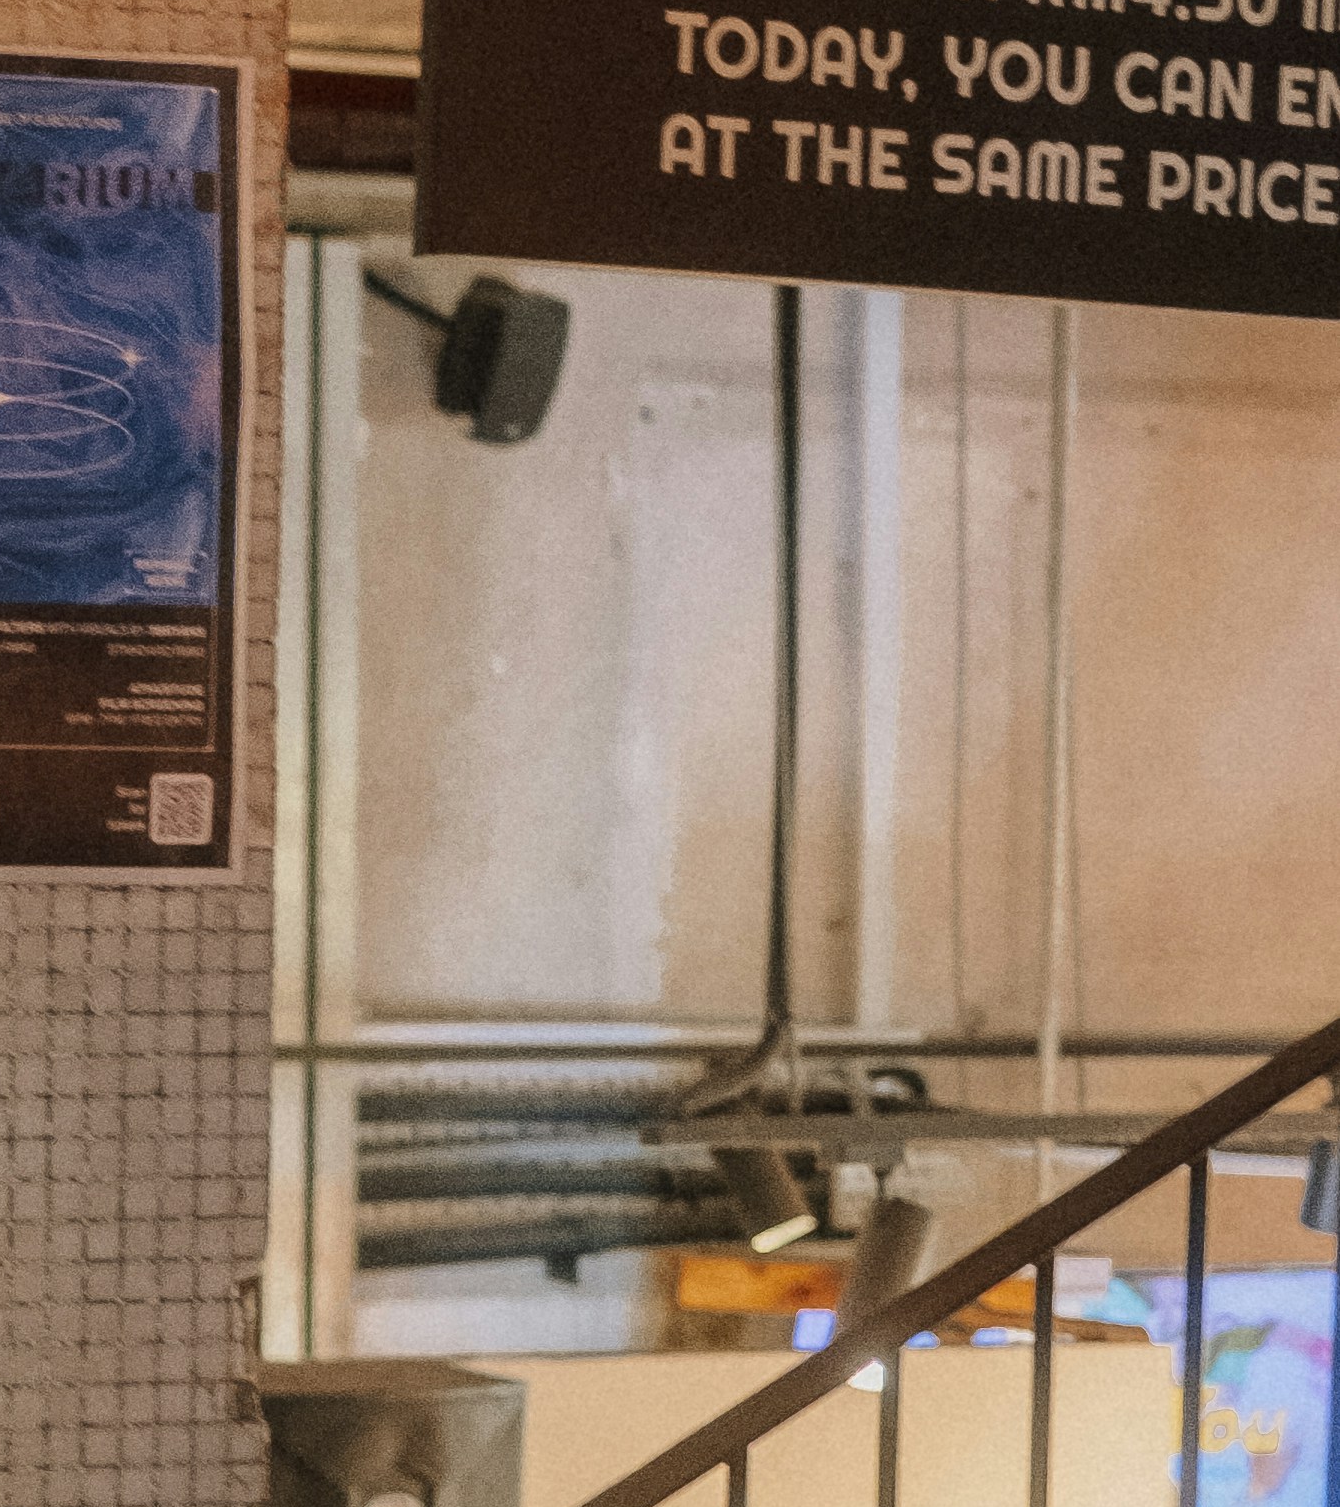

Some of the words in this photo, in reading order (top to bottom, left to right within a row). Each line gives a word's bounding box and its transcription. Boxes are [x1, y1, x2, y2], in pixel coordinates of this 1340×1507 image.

[664, 9, 919, 104] TODAY,
[942, 34, 1092, 107] YOU
[1114, 49, 1255, 124] CAN
[659, 111, 751, 179] AT
[772, 119, 910, 191] THE
[932, 132, 1125, 207] SAME
[1146, 149, 1340, 226] PRICE
